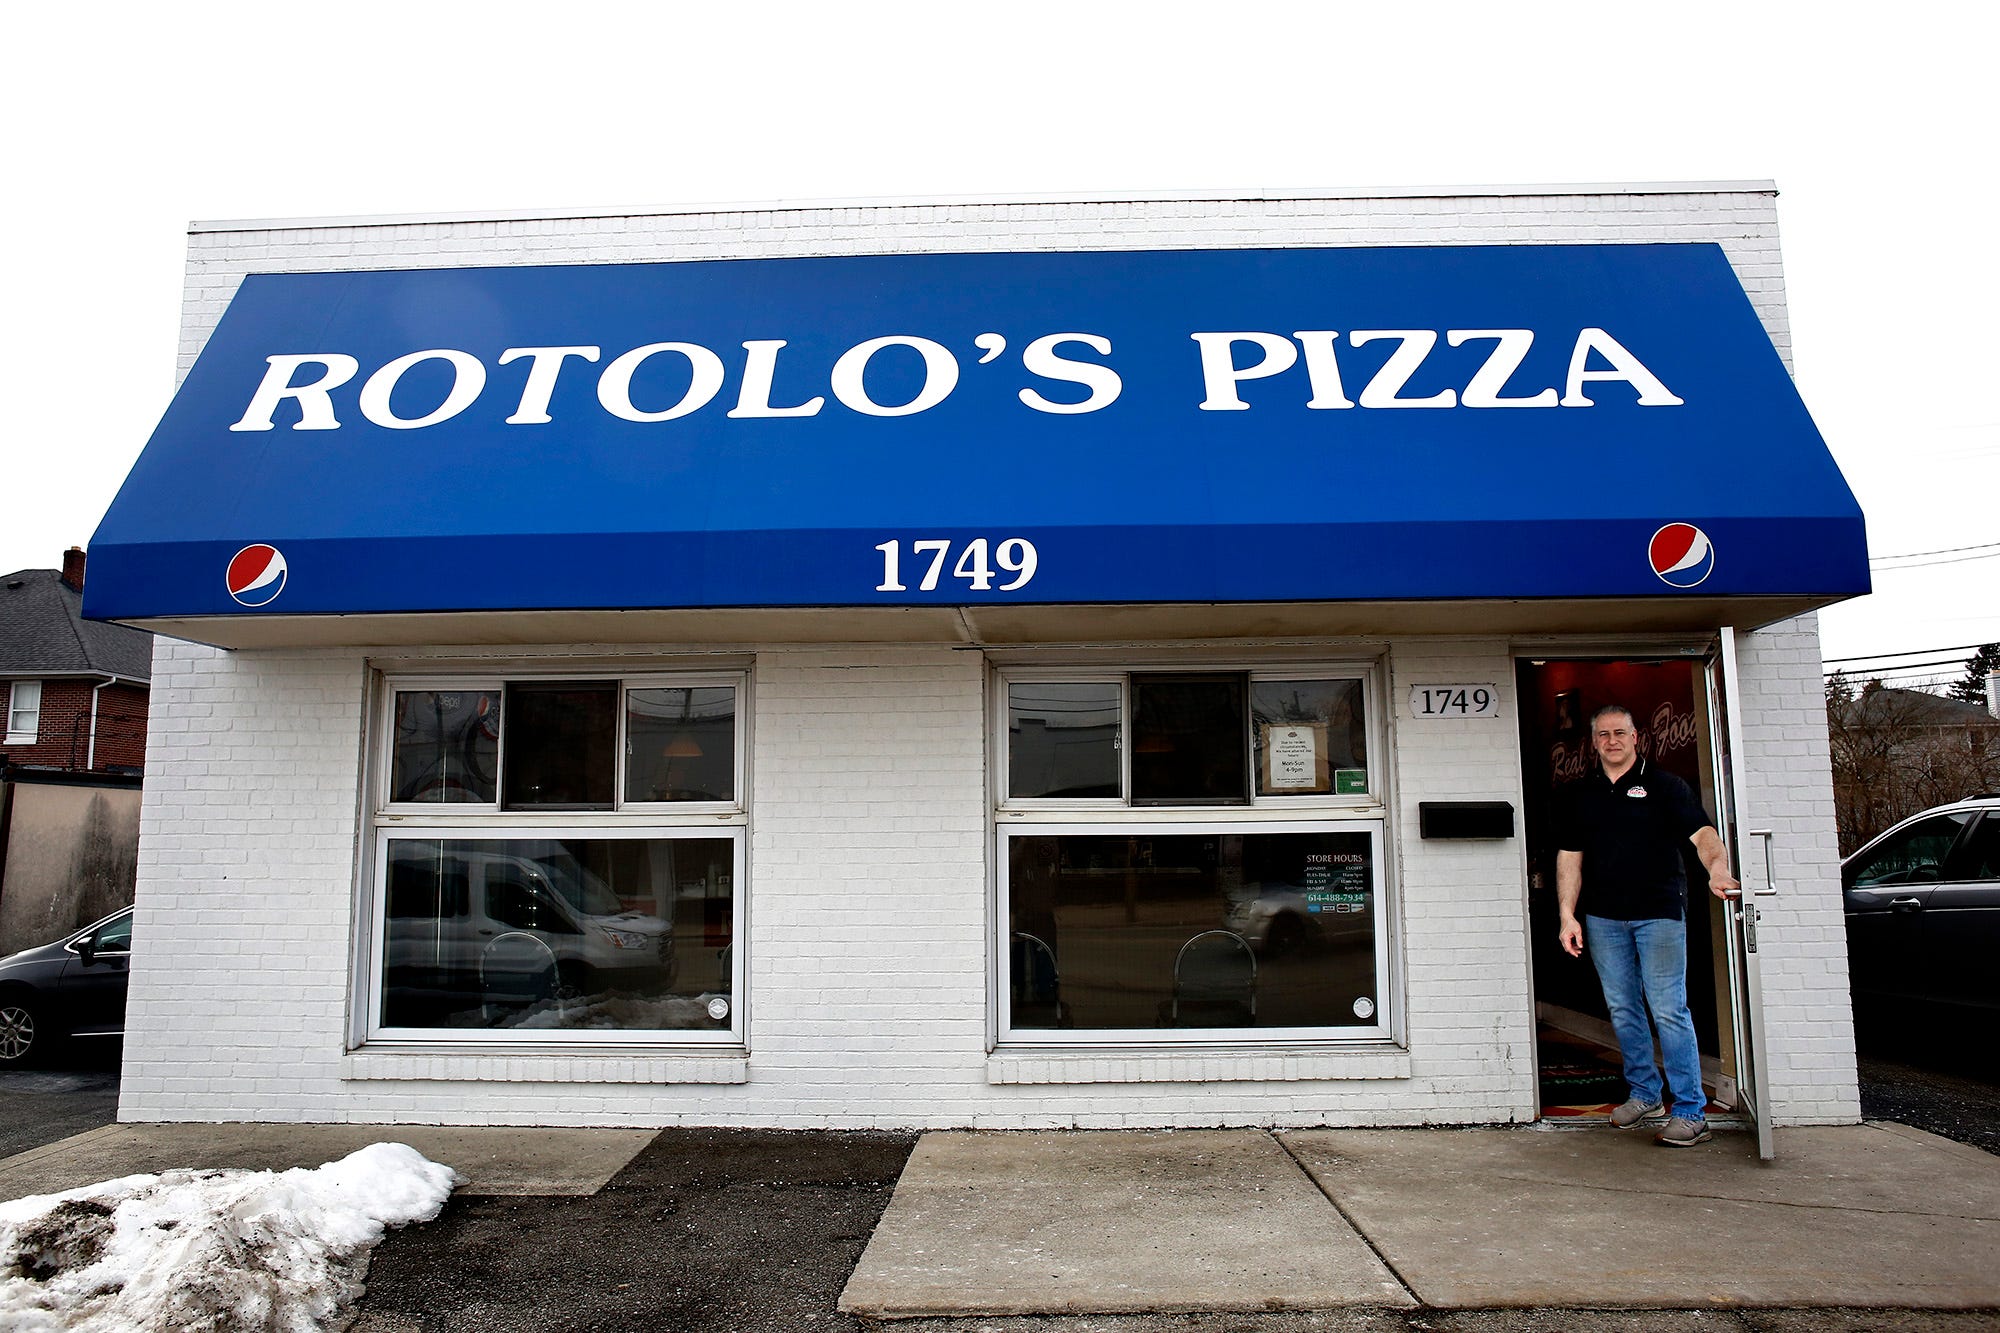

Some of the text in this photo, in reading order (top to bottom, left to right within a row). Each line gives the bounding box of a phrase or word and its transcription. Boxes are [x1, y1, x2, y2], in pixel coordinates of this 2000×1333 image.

[229, 327, 1685, 432] ROTOLO'S PIZZA
[875, 537, 1038, 593] 1749
[1422, 688, 1490, 714] 1749
[1306, 854, 1363, 863] STORE HOURS
[1308, 893, 1364, 902] 614-488-7934
